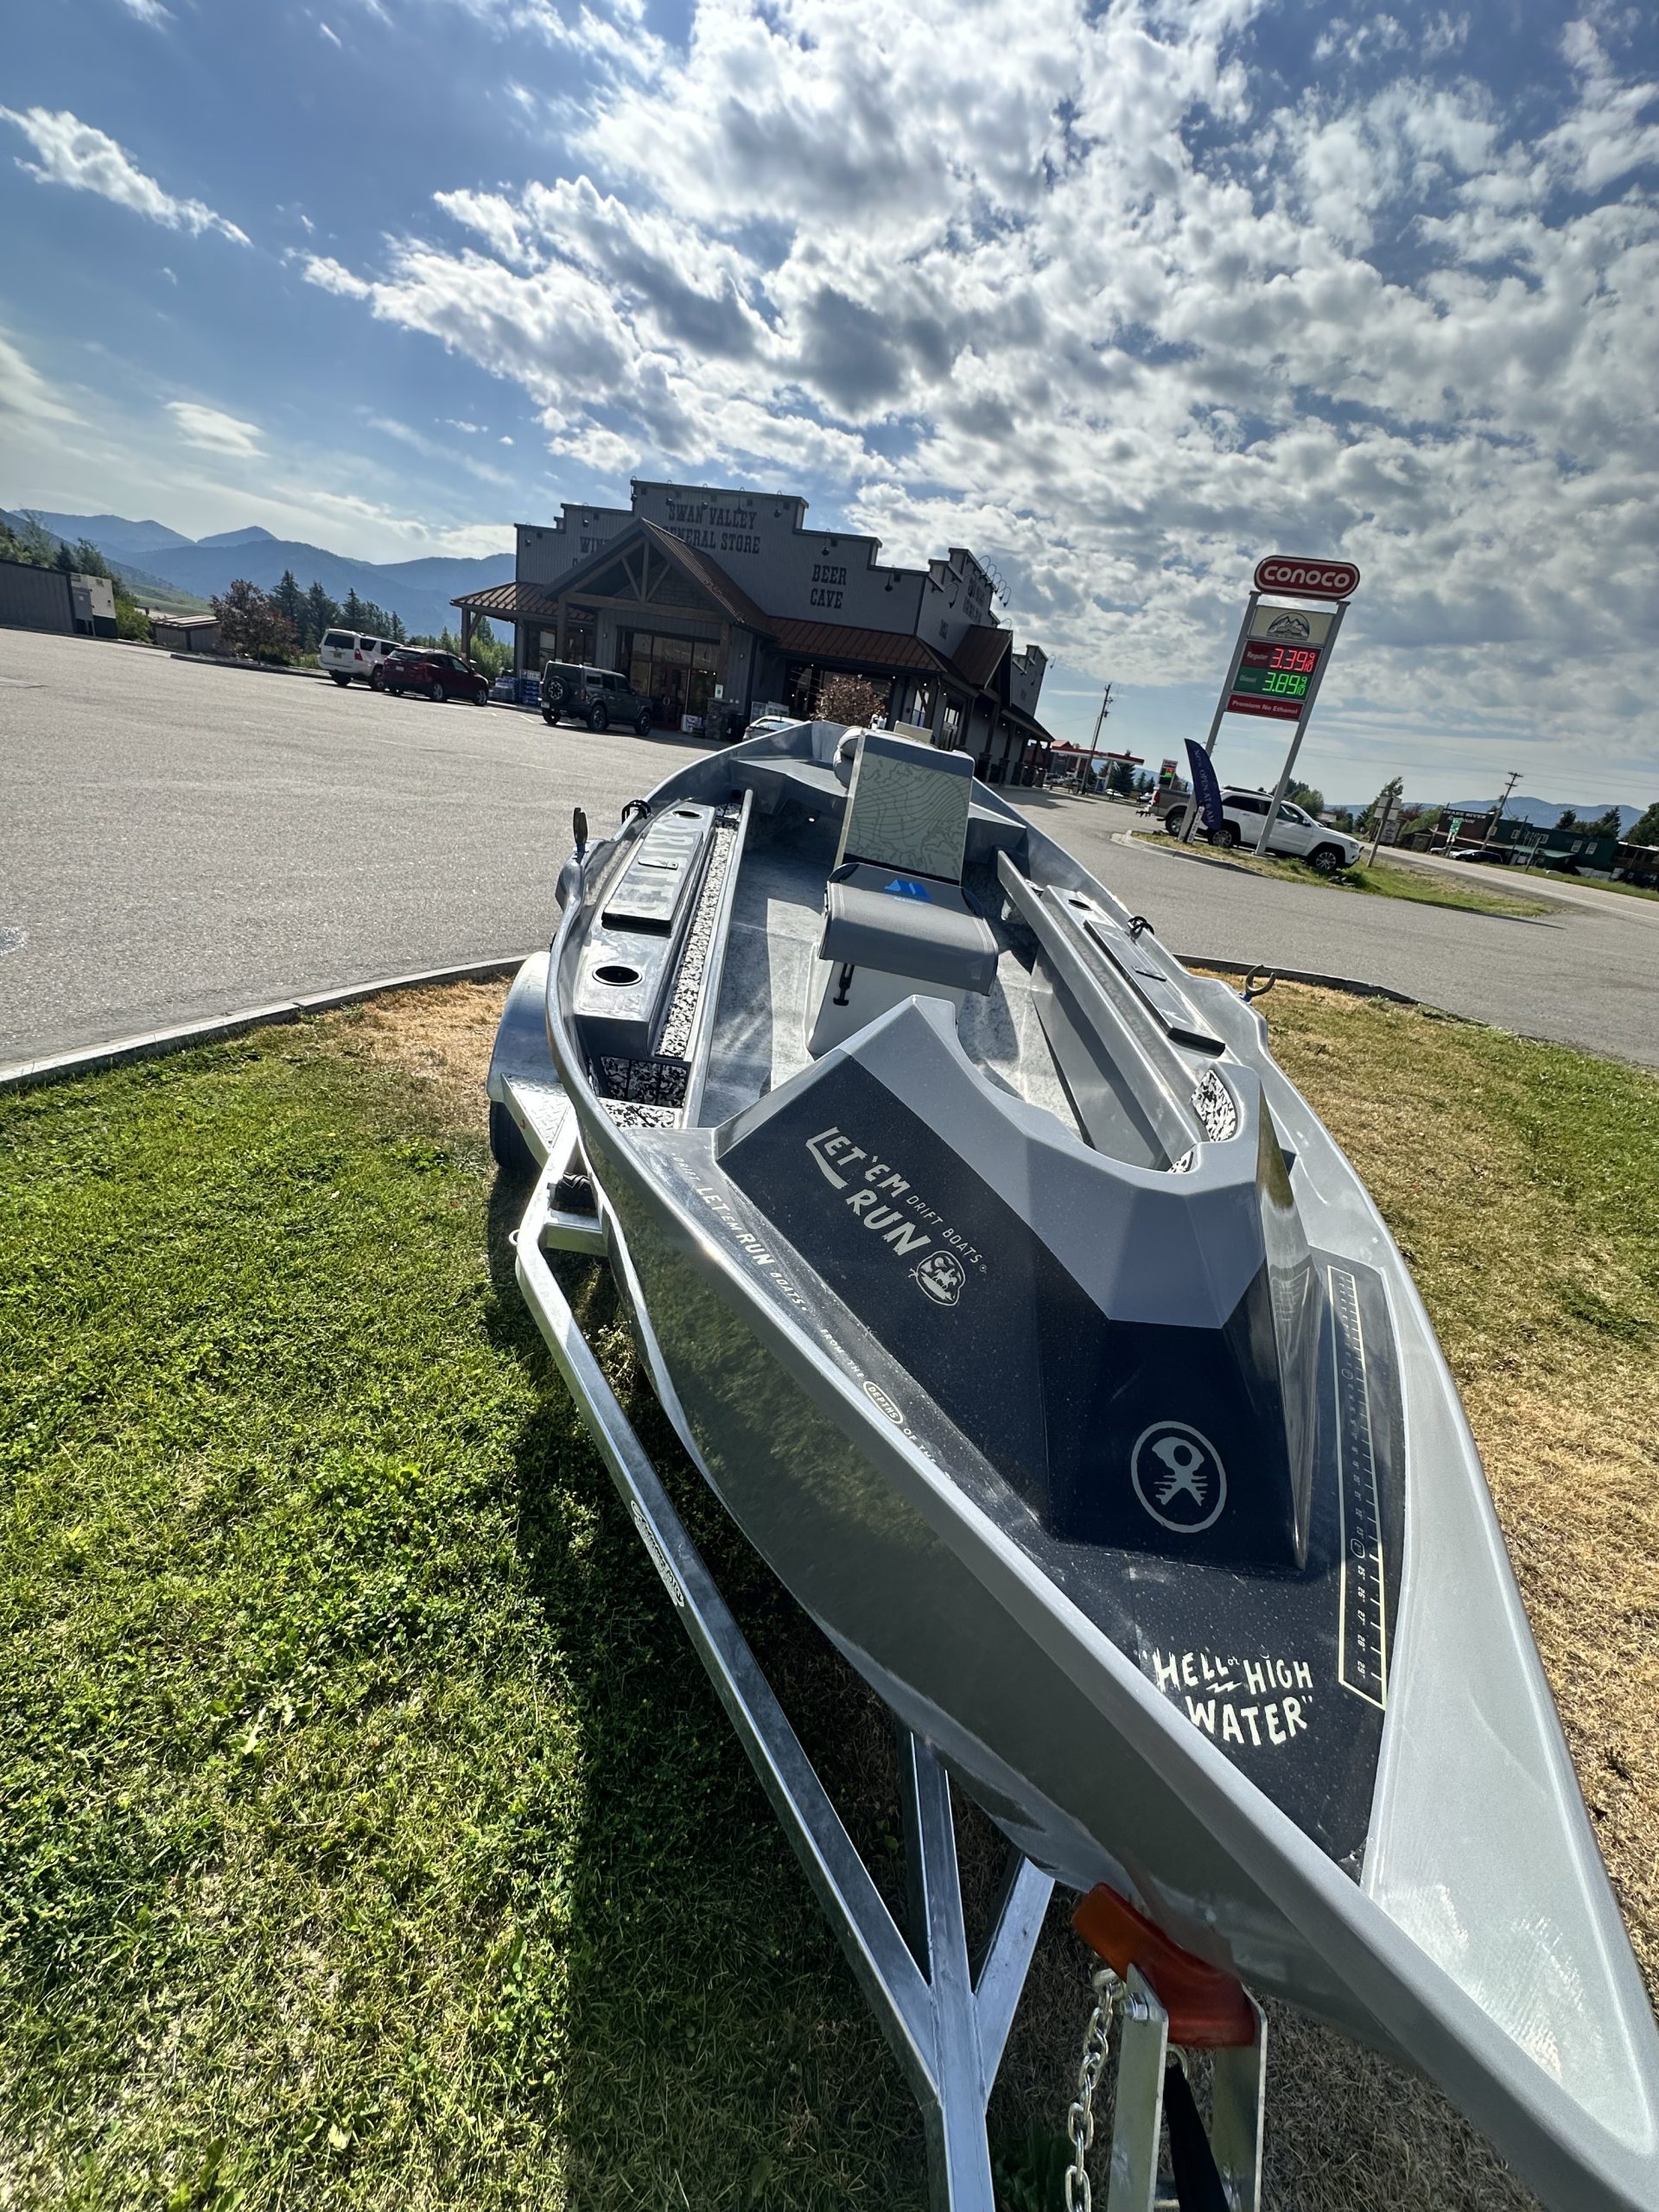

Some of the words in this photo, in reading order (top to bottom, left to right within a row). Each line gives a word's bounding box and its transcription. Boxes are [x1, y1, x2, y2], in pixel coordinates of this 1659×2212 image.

[668, 503, 708, 524] SWAN
[709, 505, 758, 530] VALLEY
[721, 531, 761, 555] STORE
[811, 563, 847, 586] BEER
[810, 588, 843, 609] CAVE
[1269, 647, 1309, 672] 3.39
[1262, 671, 1301, 695] 3.89
[1231, 699, 1262, 710] Premium
[1262, 702, 1272, 711] No
[1272, 705, 1299, 715] Ethanol
[805, 1126, 868, 1190] LET
[845, 1188, 932, 1256] RUN
[906, 1195, 944, 1226] DRIFT
[672, 1155, 702, 1183] DRIFT
[696, 1186, 730, 1211] LET
[735, 1232, 776, 1266] RUN
[769, 1271, 806, 1305] BOATS
[820, 1328, 846, 1355] FROM
[847, 1359, 865, 1378] THE
[867, 1385, 899, 1420] DEPTHS
[903, 1427, 918, 1442] OF
[1243, 1658, 1313, 1695] HIGH
